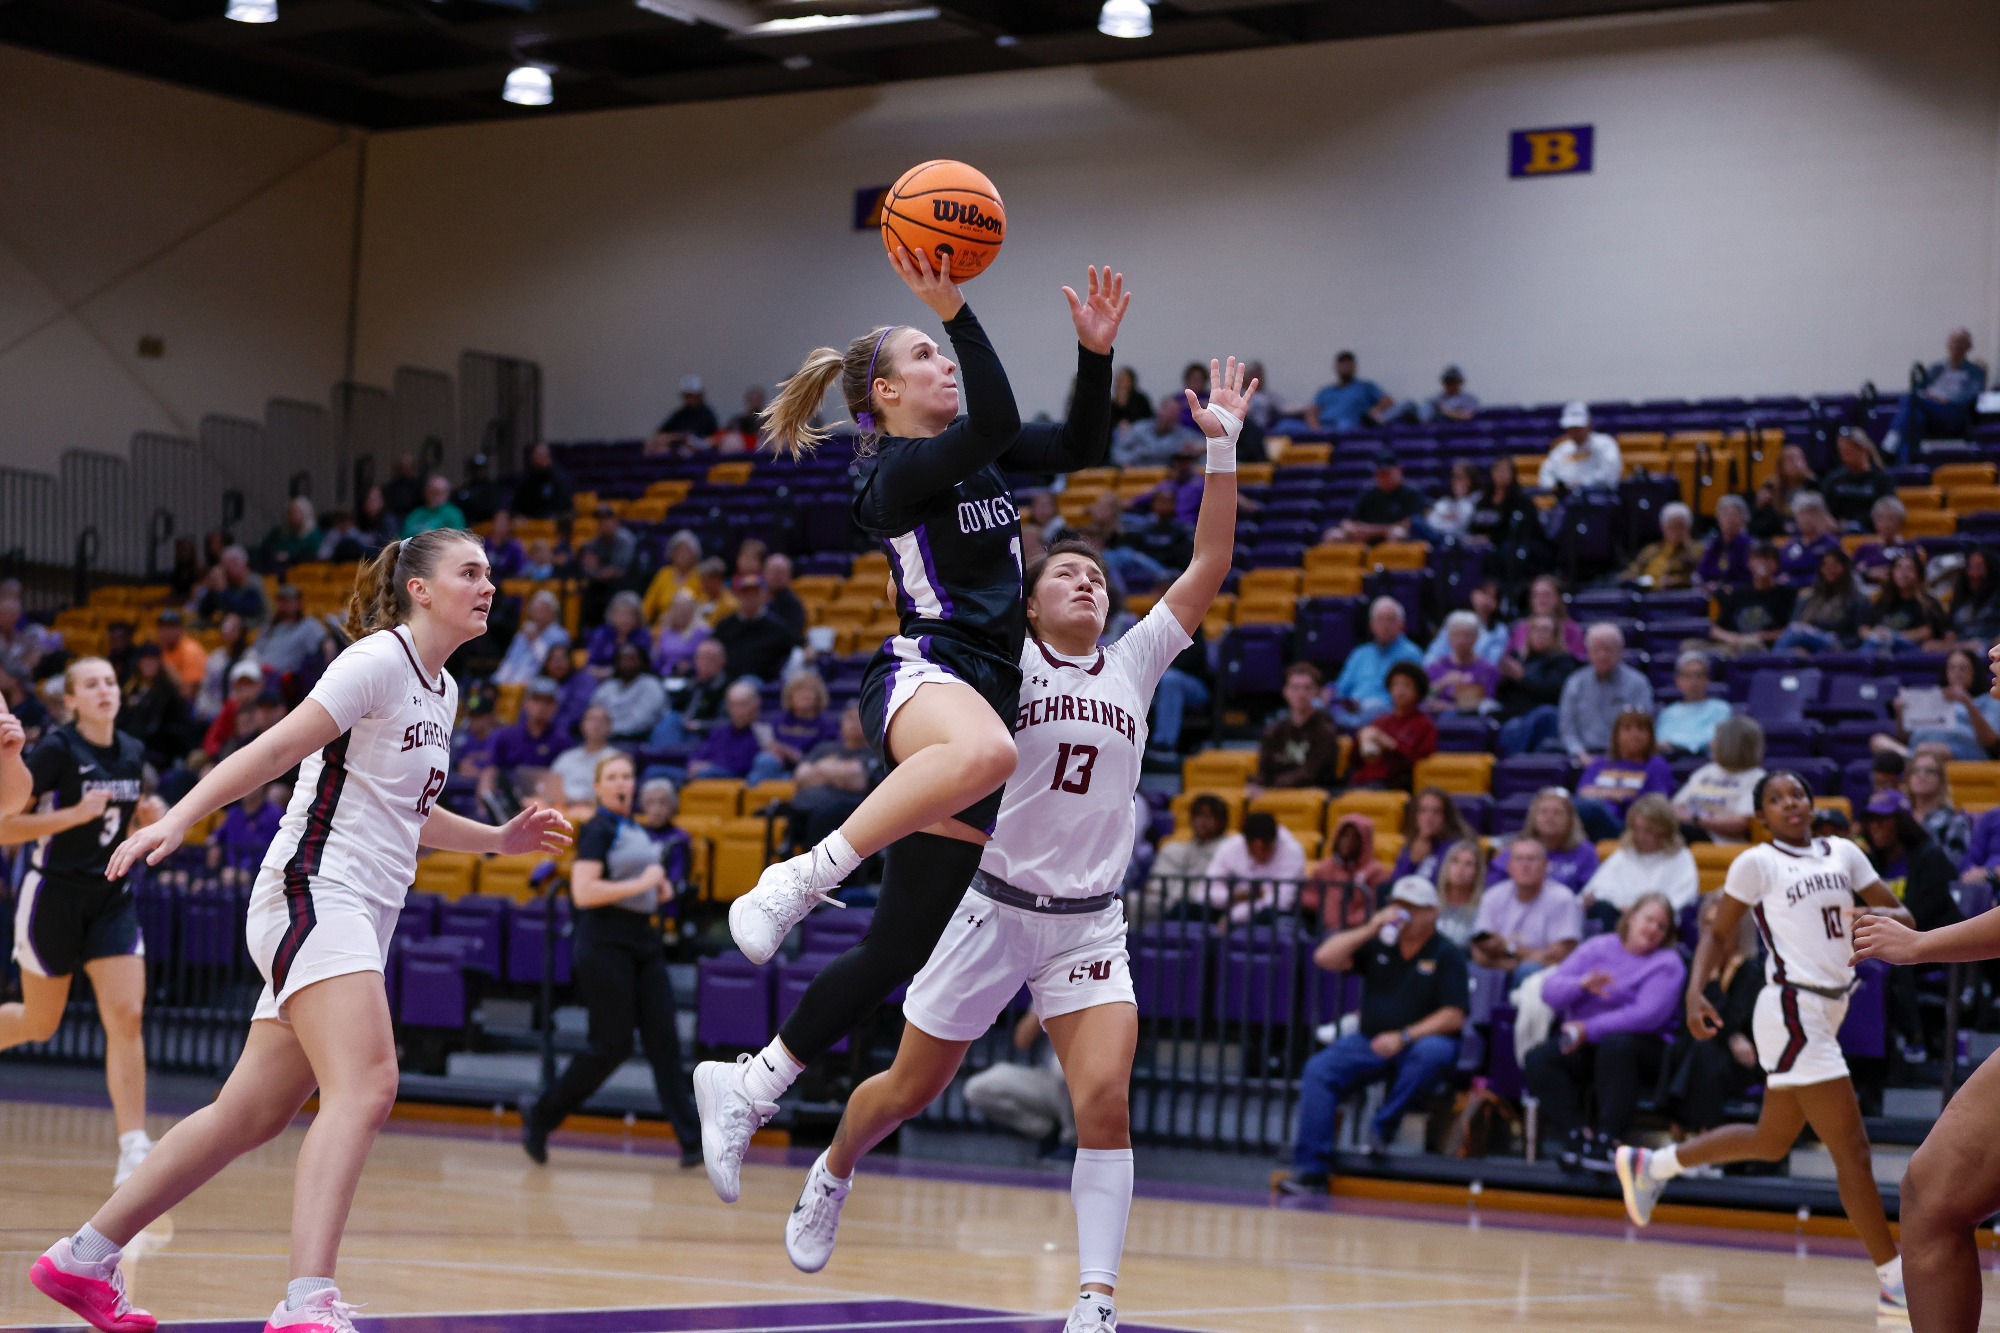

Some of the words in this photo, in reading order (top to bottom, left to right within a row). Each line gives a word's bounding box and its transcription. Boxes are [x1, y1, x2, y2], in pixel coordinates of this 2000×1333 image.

[1524, 131, 1578, 173] B
[933, 199, 1002, 235] Wilson
[1014, 694, 1136, 746] SCHREINER
[1050, 743, 1099, 795] 13
[416, 766, 446, 817] 12
[98, 806, 121, 847] 3
[1821, 905, 1844, 940] 10
